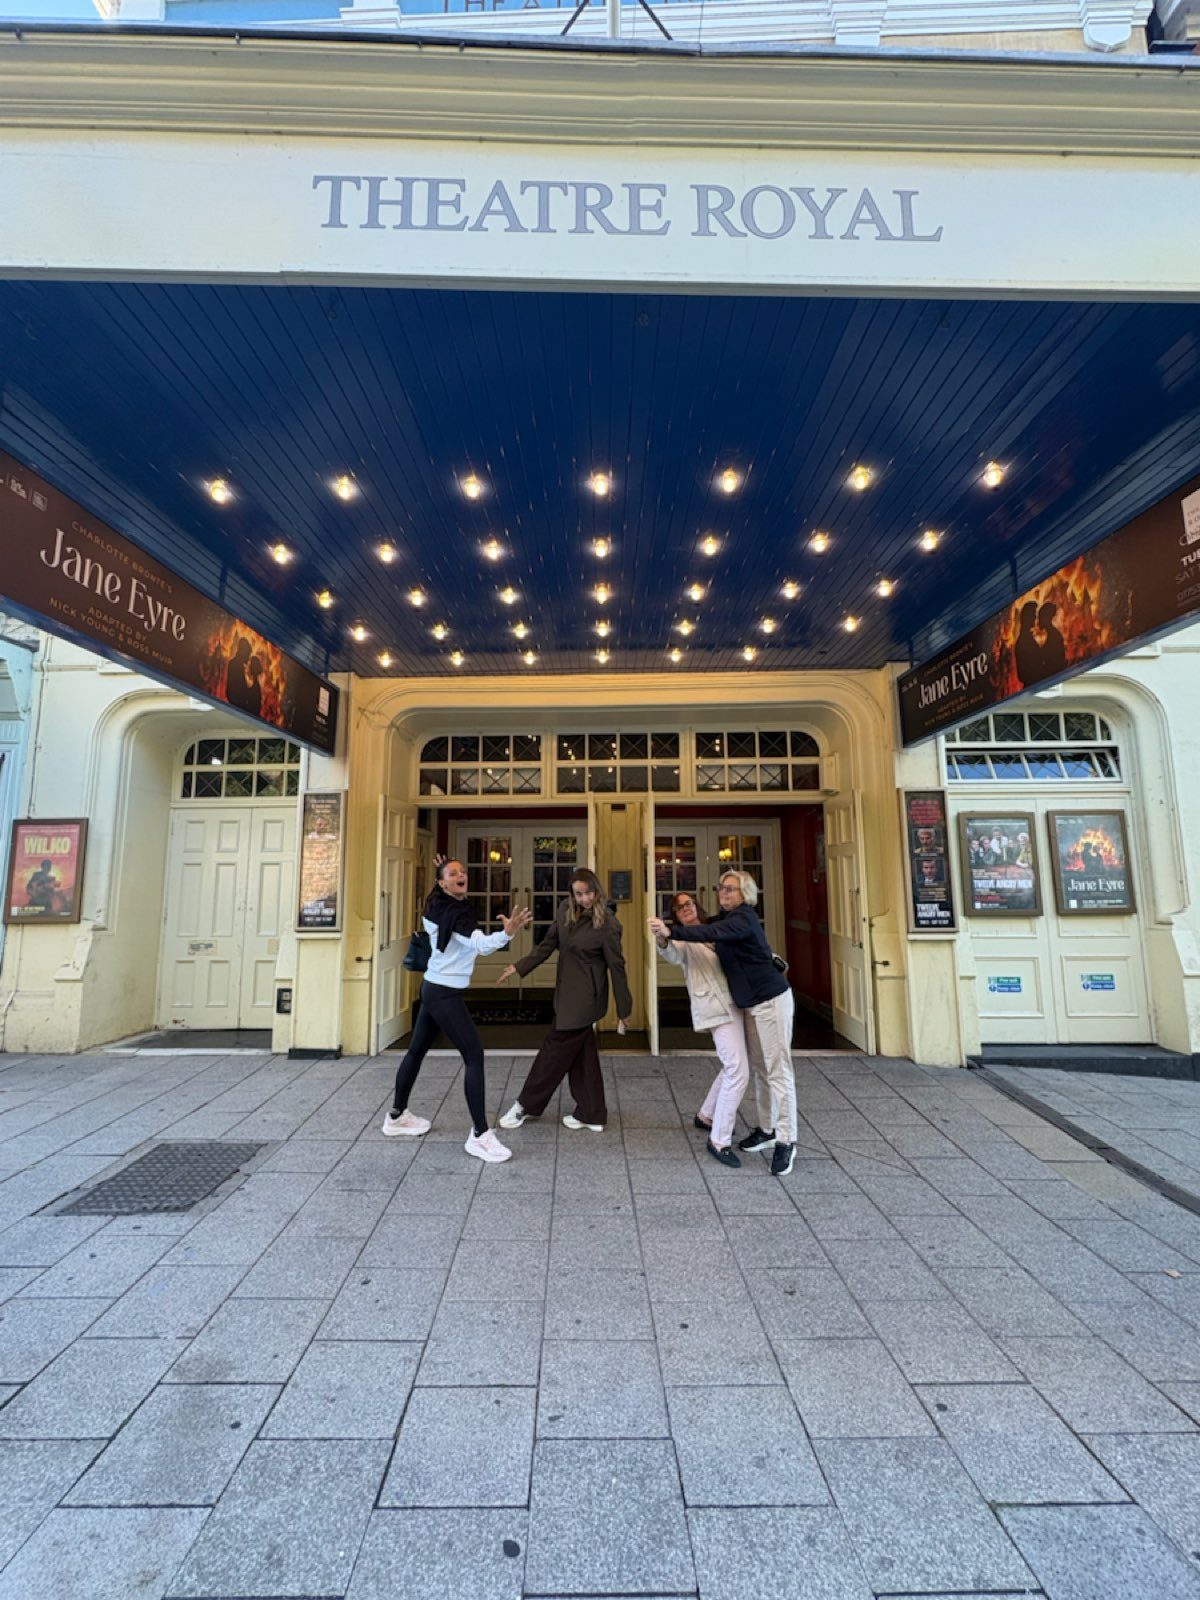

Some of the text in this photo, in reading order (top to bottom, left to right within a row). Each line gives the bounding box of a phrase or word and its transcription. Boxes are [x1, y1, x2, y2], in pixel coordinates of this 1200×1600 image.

[312, 175, 944, 242] THEATRE ROYAL
[71, 520, 129, 565] CHARLOTTE
[40, 528, 186, 641] Jane Eyre
[49, 597, 78, 617] NICK
[81, 613, 115, 637] YOUNG
[127, 638, 150, 655] ROSS
[152, 650, 173, 666] MUIR
[88, 606, 147, 642] ADAPTED BY
[918, 675, 950, 709] Jane
[951, 652, 988, 690] Eyre
[24, 835, 71, 854] WILKO
[1068, 878, 1125, 893] Jane Eyre
